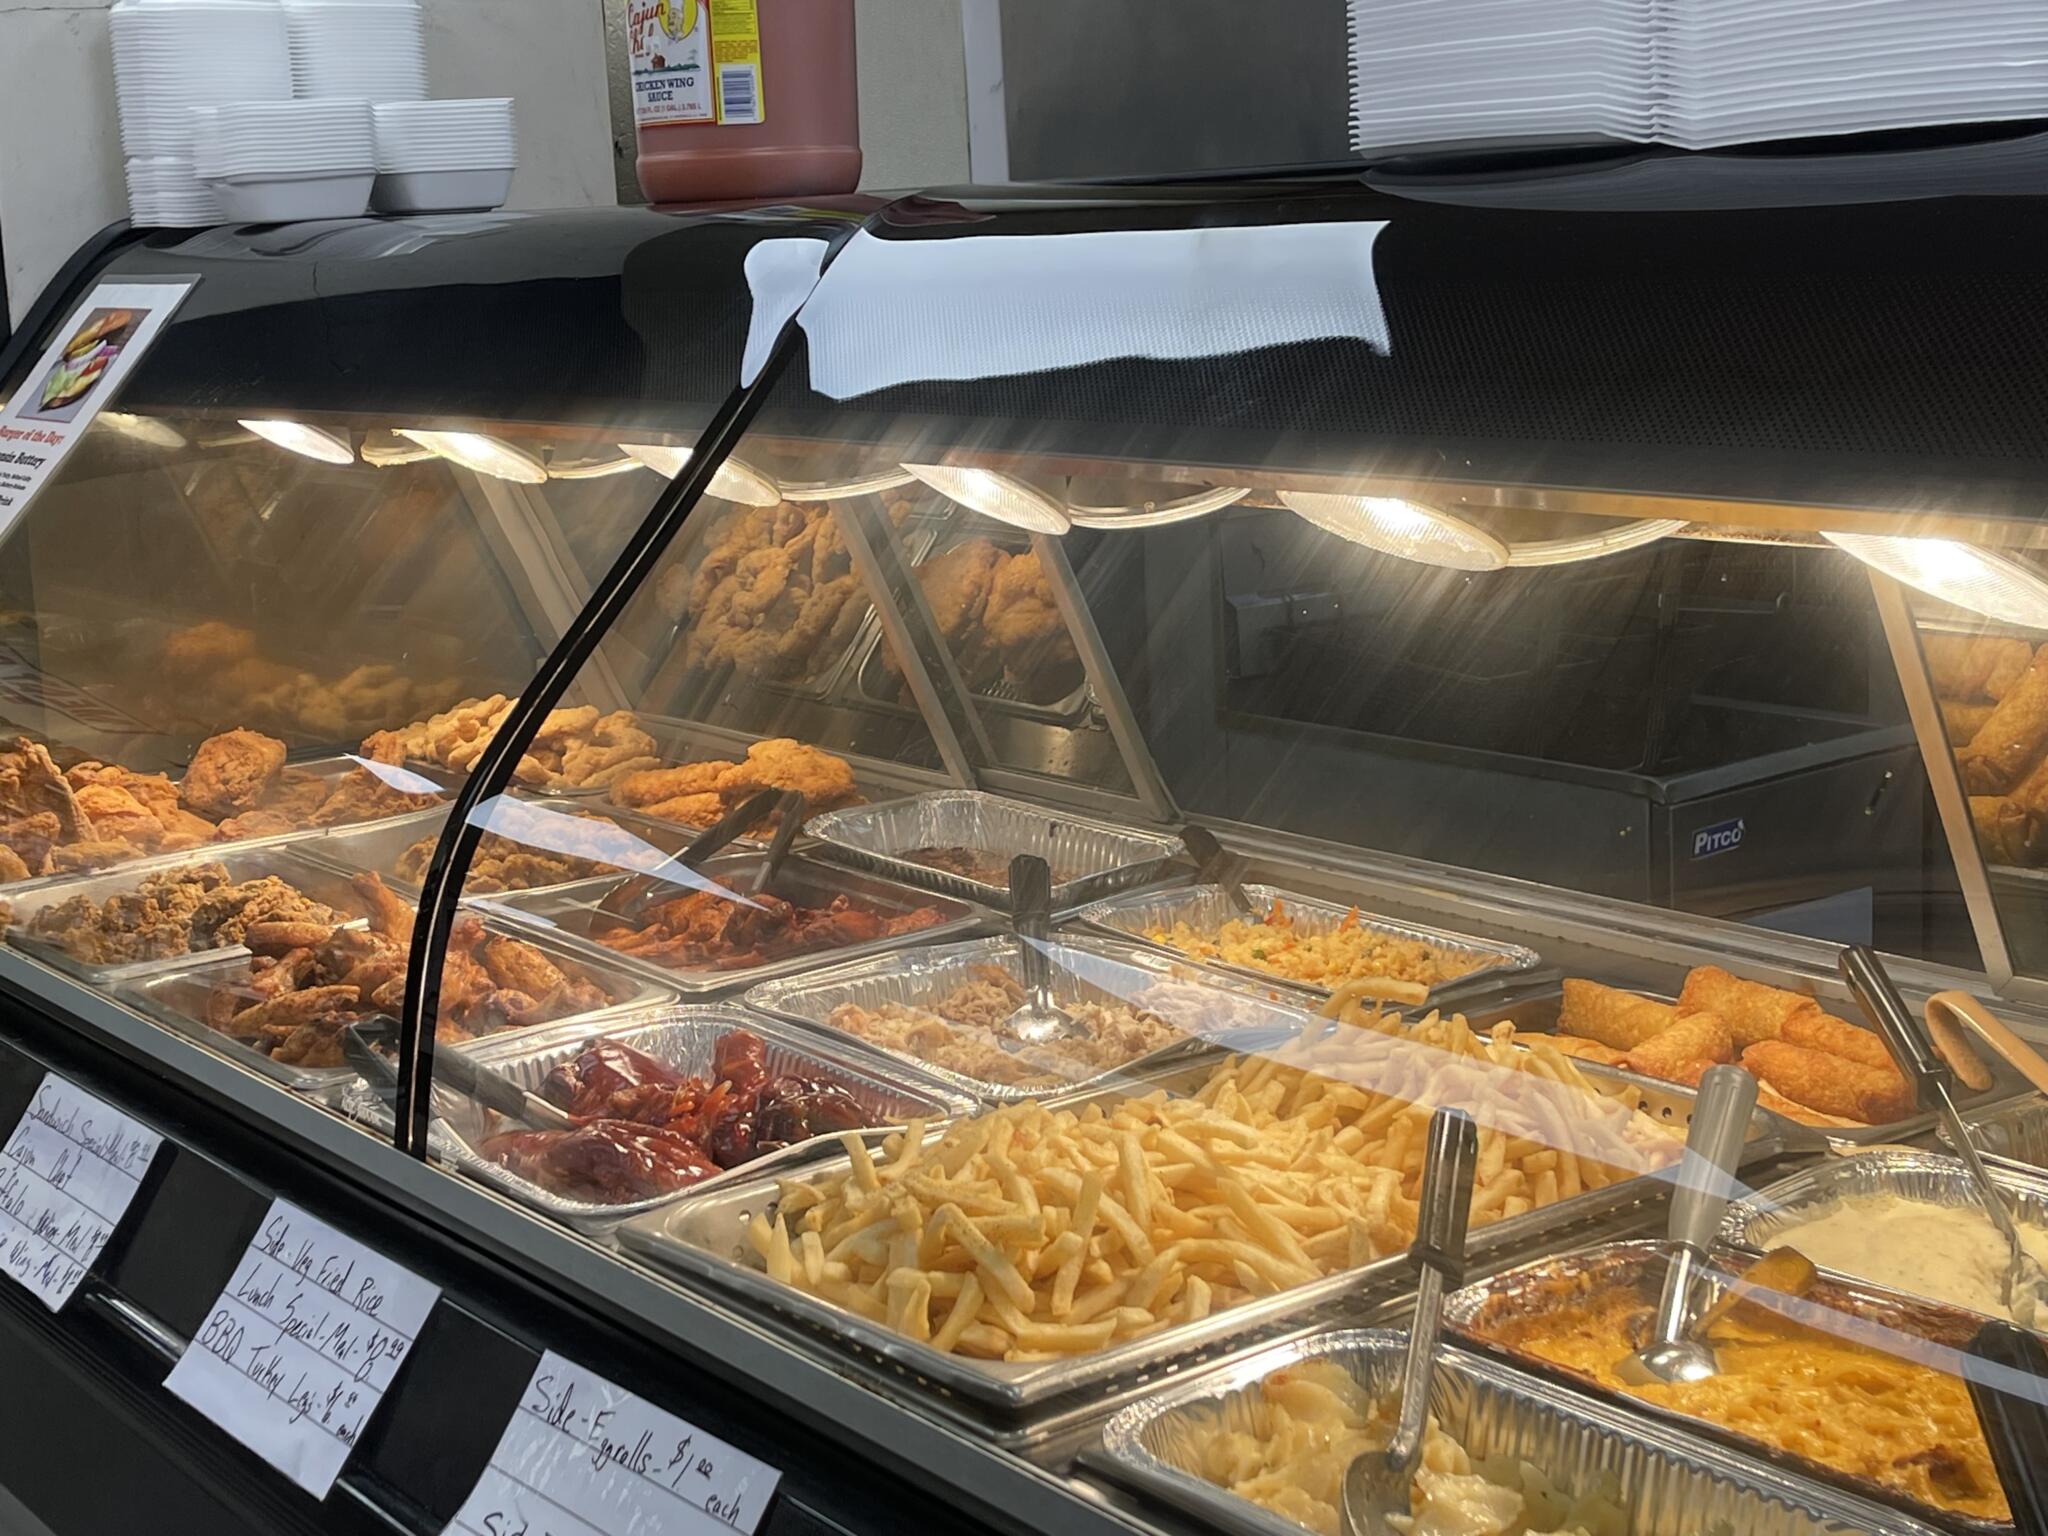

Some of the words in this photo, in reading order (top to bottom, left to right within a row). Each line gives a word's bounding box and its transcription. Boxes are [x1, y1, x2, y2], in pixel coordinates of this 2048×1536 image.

[628, 0, 666, 35] Cajun
[648, 91, 673, 102] SAUCE
[667, 77, 694, 89] WING
[22, 429, 36, 440] of
[31, 430, 46, 443] the
[8, 1126, 35, 1171] Cajun
[237, 1262, 283, 1309] Lunch
[260, 1216, 289, 1259] Side
[293, 1239, 314, 1286] Veg
[316, 1256, 355, 1297] Fried
[353, 1277, 384, 1317] Rice
[201, 1310, 245, 1365] BBQ
[247, 1345, 286, 1400] Turkey
[532, 1376, 577, 1434] Side
[705, 1494, 741, 1528] each
[484, 1512, 529, 1536] Sid
